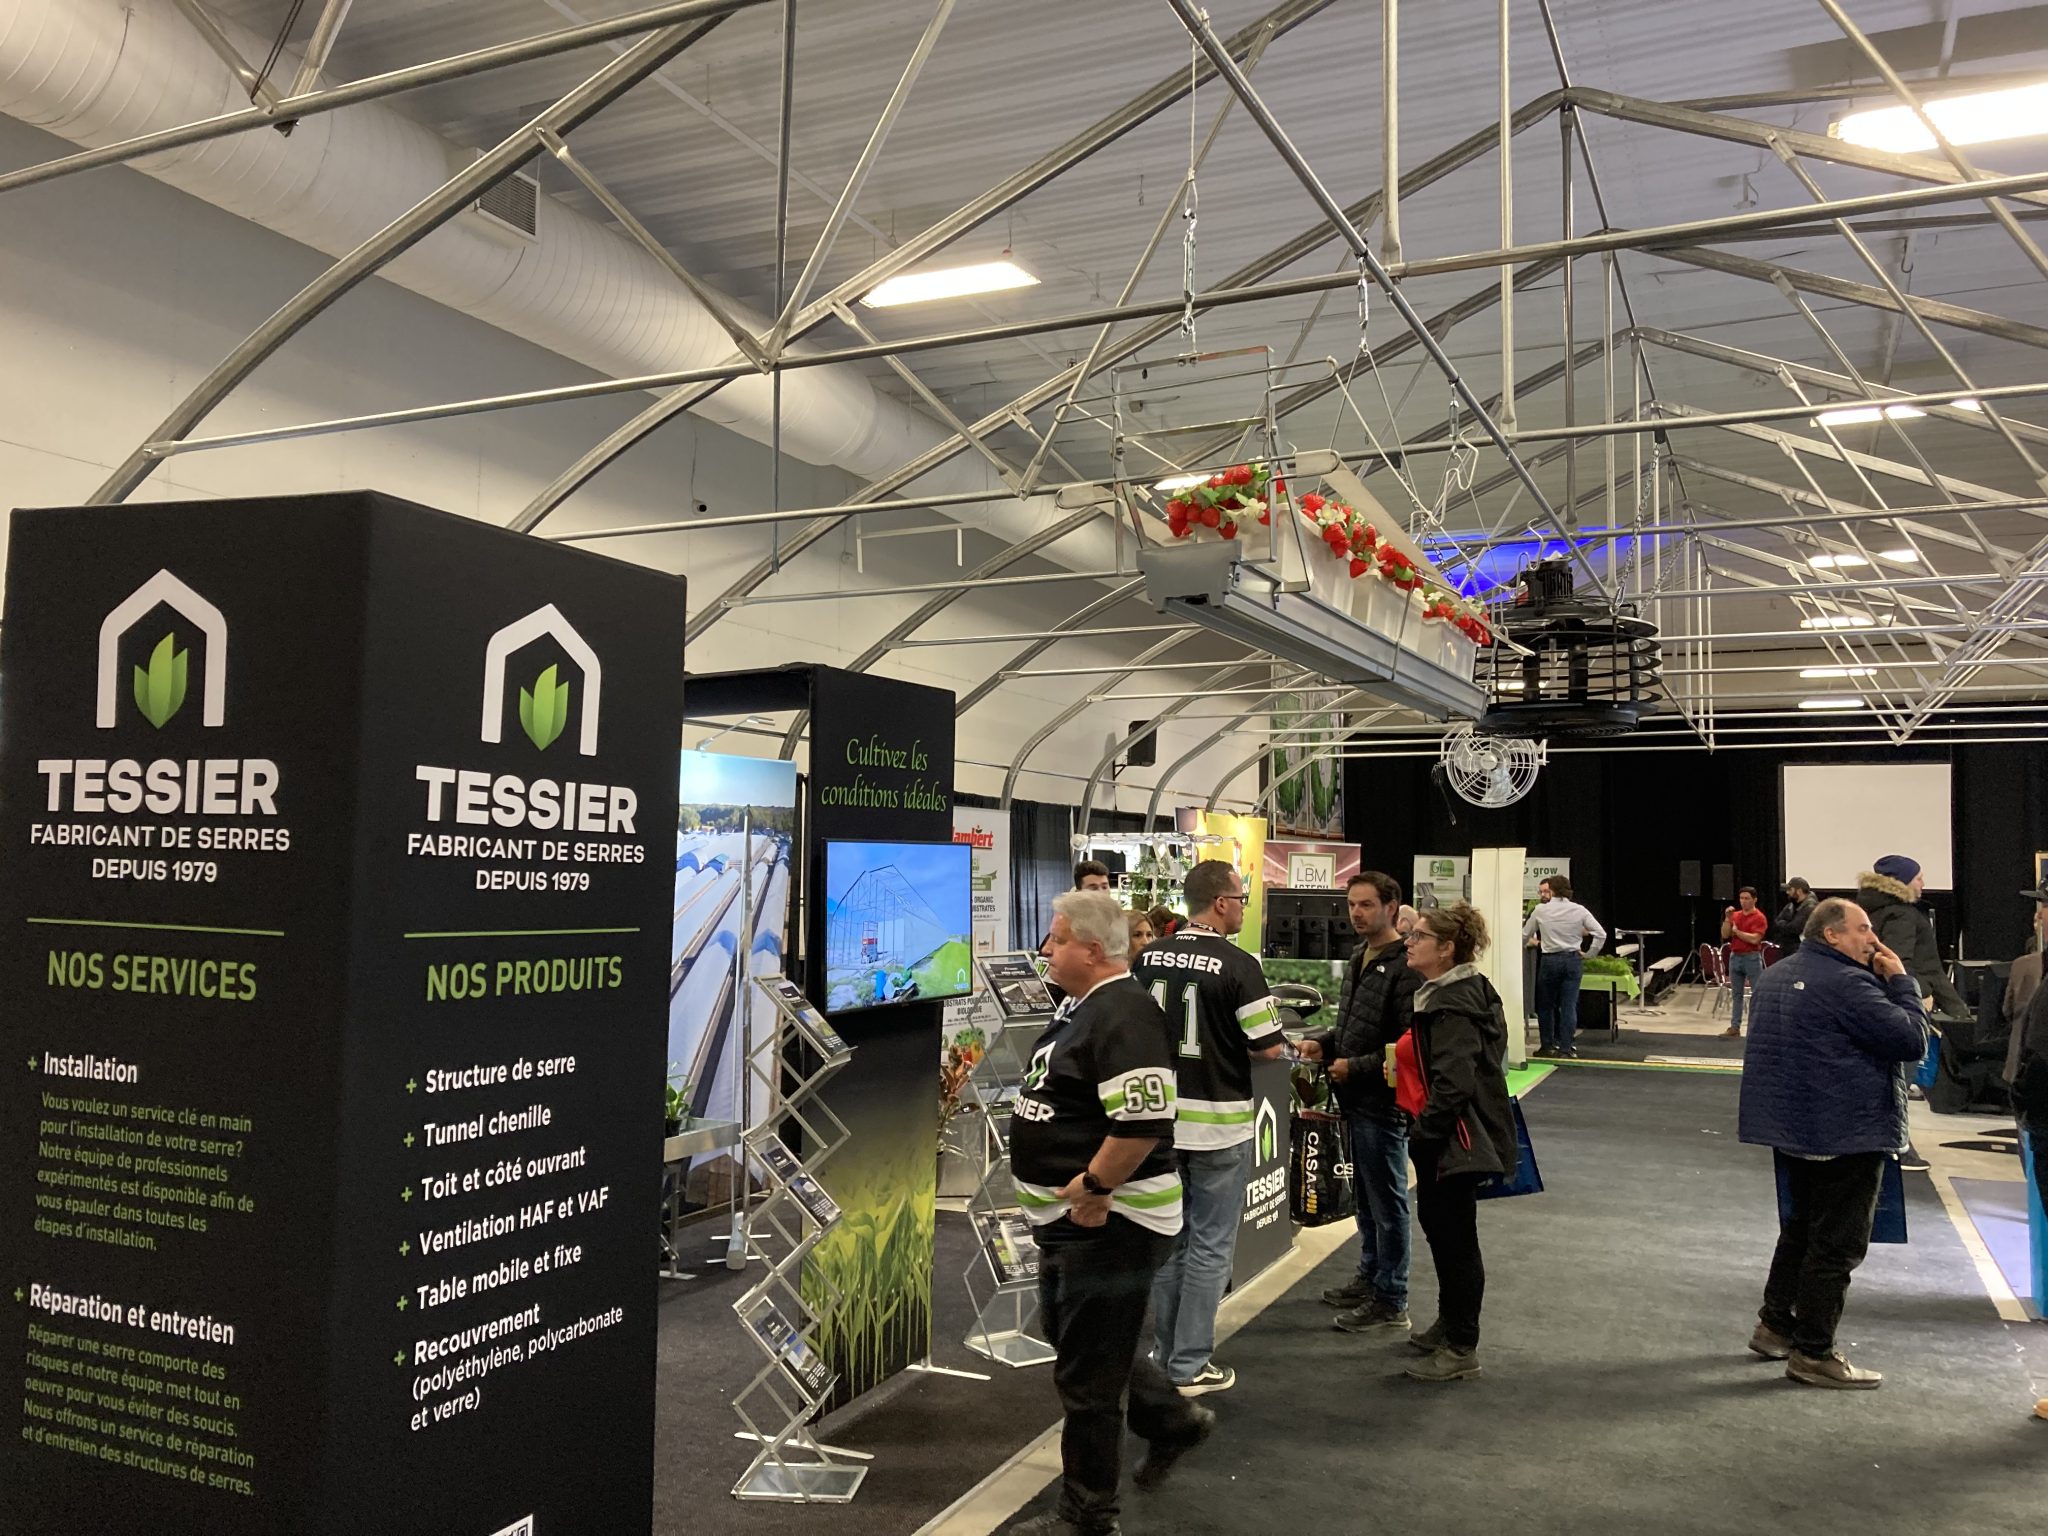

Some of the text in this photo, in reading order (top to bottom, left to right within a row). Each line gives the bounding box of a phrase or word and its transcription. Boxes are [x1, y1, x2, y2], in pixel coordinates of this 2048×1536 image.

[847, 734, 928, 771] Cultivez les
[38, 759, 279, 815] TESSIER
[416, 765, 638, 834] TESSIER
[821, 774, 947, 811] conditions idéales
[30, 824, 290, 851] FABRICANT DE SERRES
[407, 833, 645, 864] FABRICANT DE SERRES
[92, 858, 218, 883] DEPUIS 1979
[476, 870, 590, 891] DEPUIS 1979
[1296, 868, 1327, 883] LBM
[1533, 865, 1557, 878] grow
[48, 950, 257, 1001] NOS SERVICES
[427, 956, 622, 1001] NOS PRODUITS
[1142, 951, 1223, 975] TESSIER
[44, 1051, 138, 1084] Installation
[425, 1055, 576, 1093] Structure de serre
[41, 1091, 252, 1132] Vous voulez un service clé en main
[1013, 1096, 1055, 1122] SIER
[1123, 1074, 1167, 1113] 69
[40, 1119, 243, 1158] pour l'installation de votre serre?
[424, 1104, 551, 1147] Tunnel chenille
[38, 1141, 228, 1182] Notre équipe de professionnels
[421, 1146, 586, 1201] Toit et côté ouvrant
[1306, 1131, 1319, 1184] CASA
[37, 1166, 254, 1212] expérimentés est disponible afin de
[1246, 1166, 1285, 1207] TESSIER
[34, 1215, 157, 1251] étapes d'installation.
[35, 1194, 207, 1232] vous épauler dans toutes les
[419, 1186, 609, 1256] Ventilation HAF et VAF
[417, 1245, 582, 1310] Table mobile et fixe
[30, 1283, 235, 1345] Réparation et entretien
[414, 1303, 540, 1365] Recouvrement
[28, 1323, 225, 1380] Réparer une serre comporte des
[412, 1307, 623, 1401] (polyéthylène, polycarbonate
[26, 1351, 240, 1410] risques et notre équipe met tout en
[25, 1377, 238, 1438] oeuvre pour vous éviter des soucis.
[411, 1386, 481, 1431] et verre)
[23, 1398, 254, 1469] Nous offrons un service de réparation
[22, 1425, 254, 1496] et d'entretien des structures de serres.
